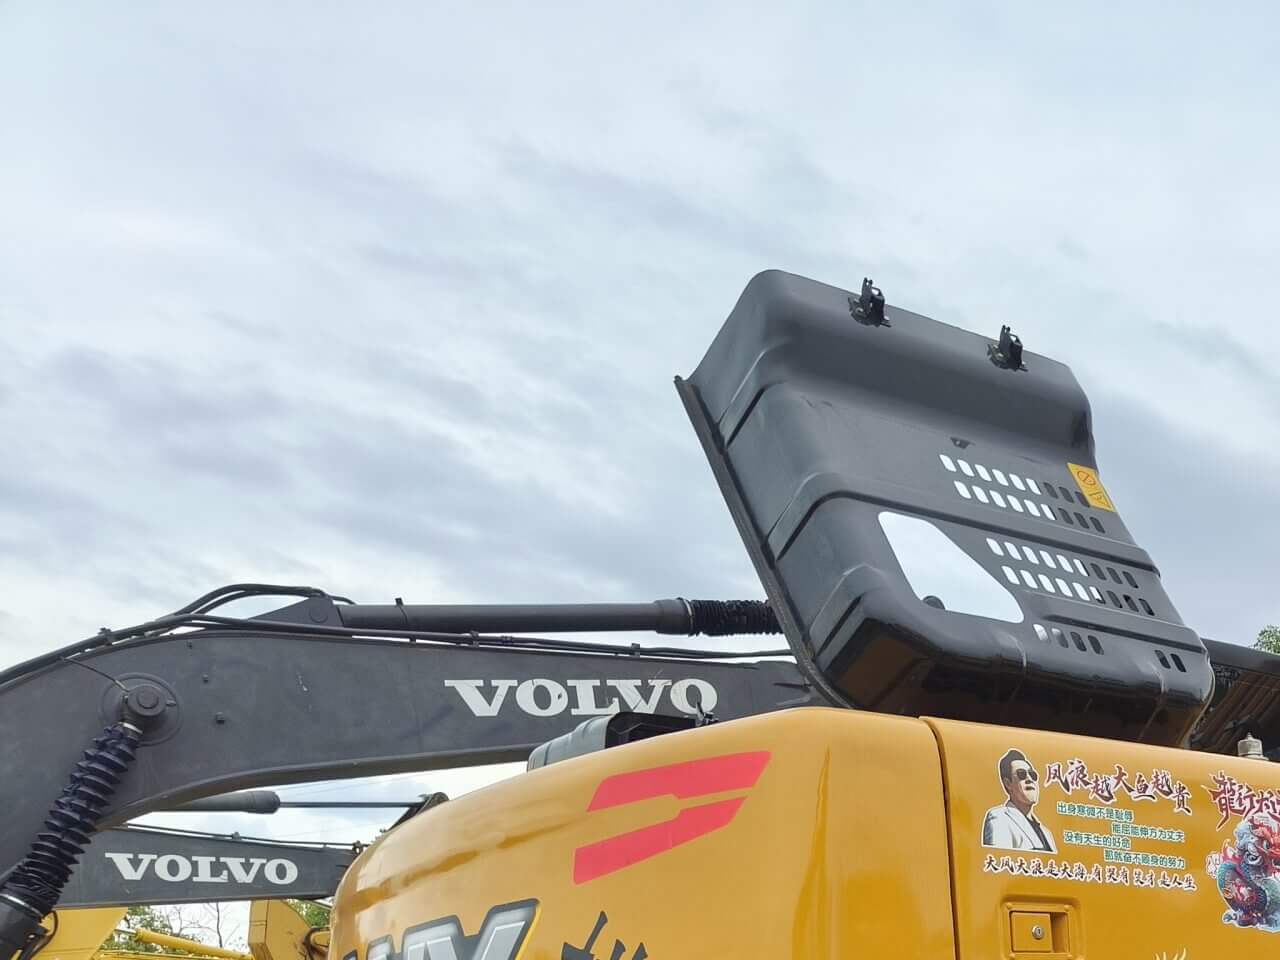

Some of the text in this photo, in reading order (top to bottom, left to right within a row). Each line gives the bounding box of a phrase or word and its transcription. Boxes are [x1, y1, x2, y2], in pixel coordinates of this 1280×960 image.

[445, 678, 718, 717] VOLVO
[1043, 757, 1194, 816] 风浪越大鱼越贵
[1063, 830, 1131, 849] 没有天生的好命
[105, 852, 299, 885] VOLVO
